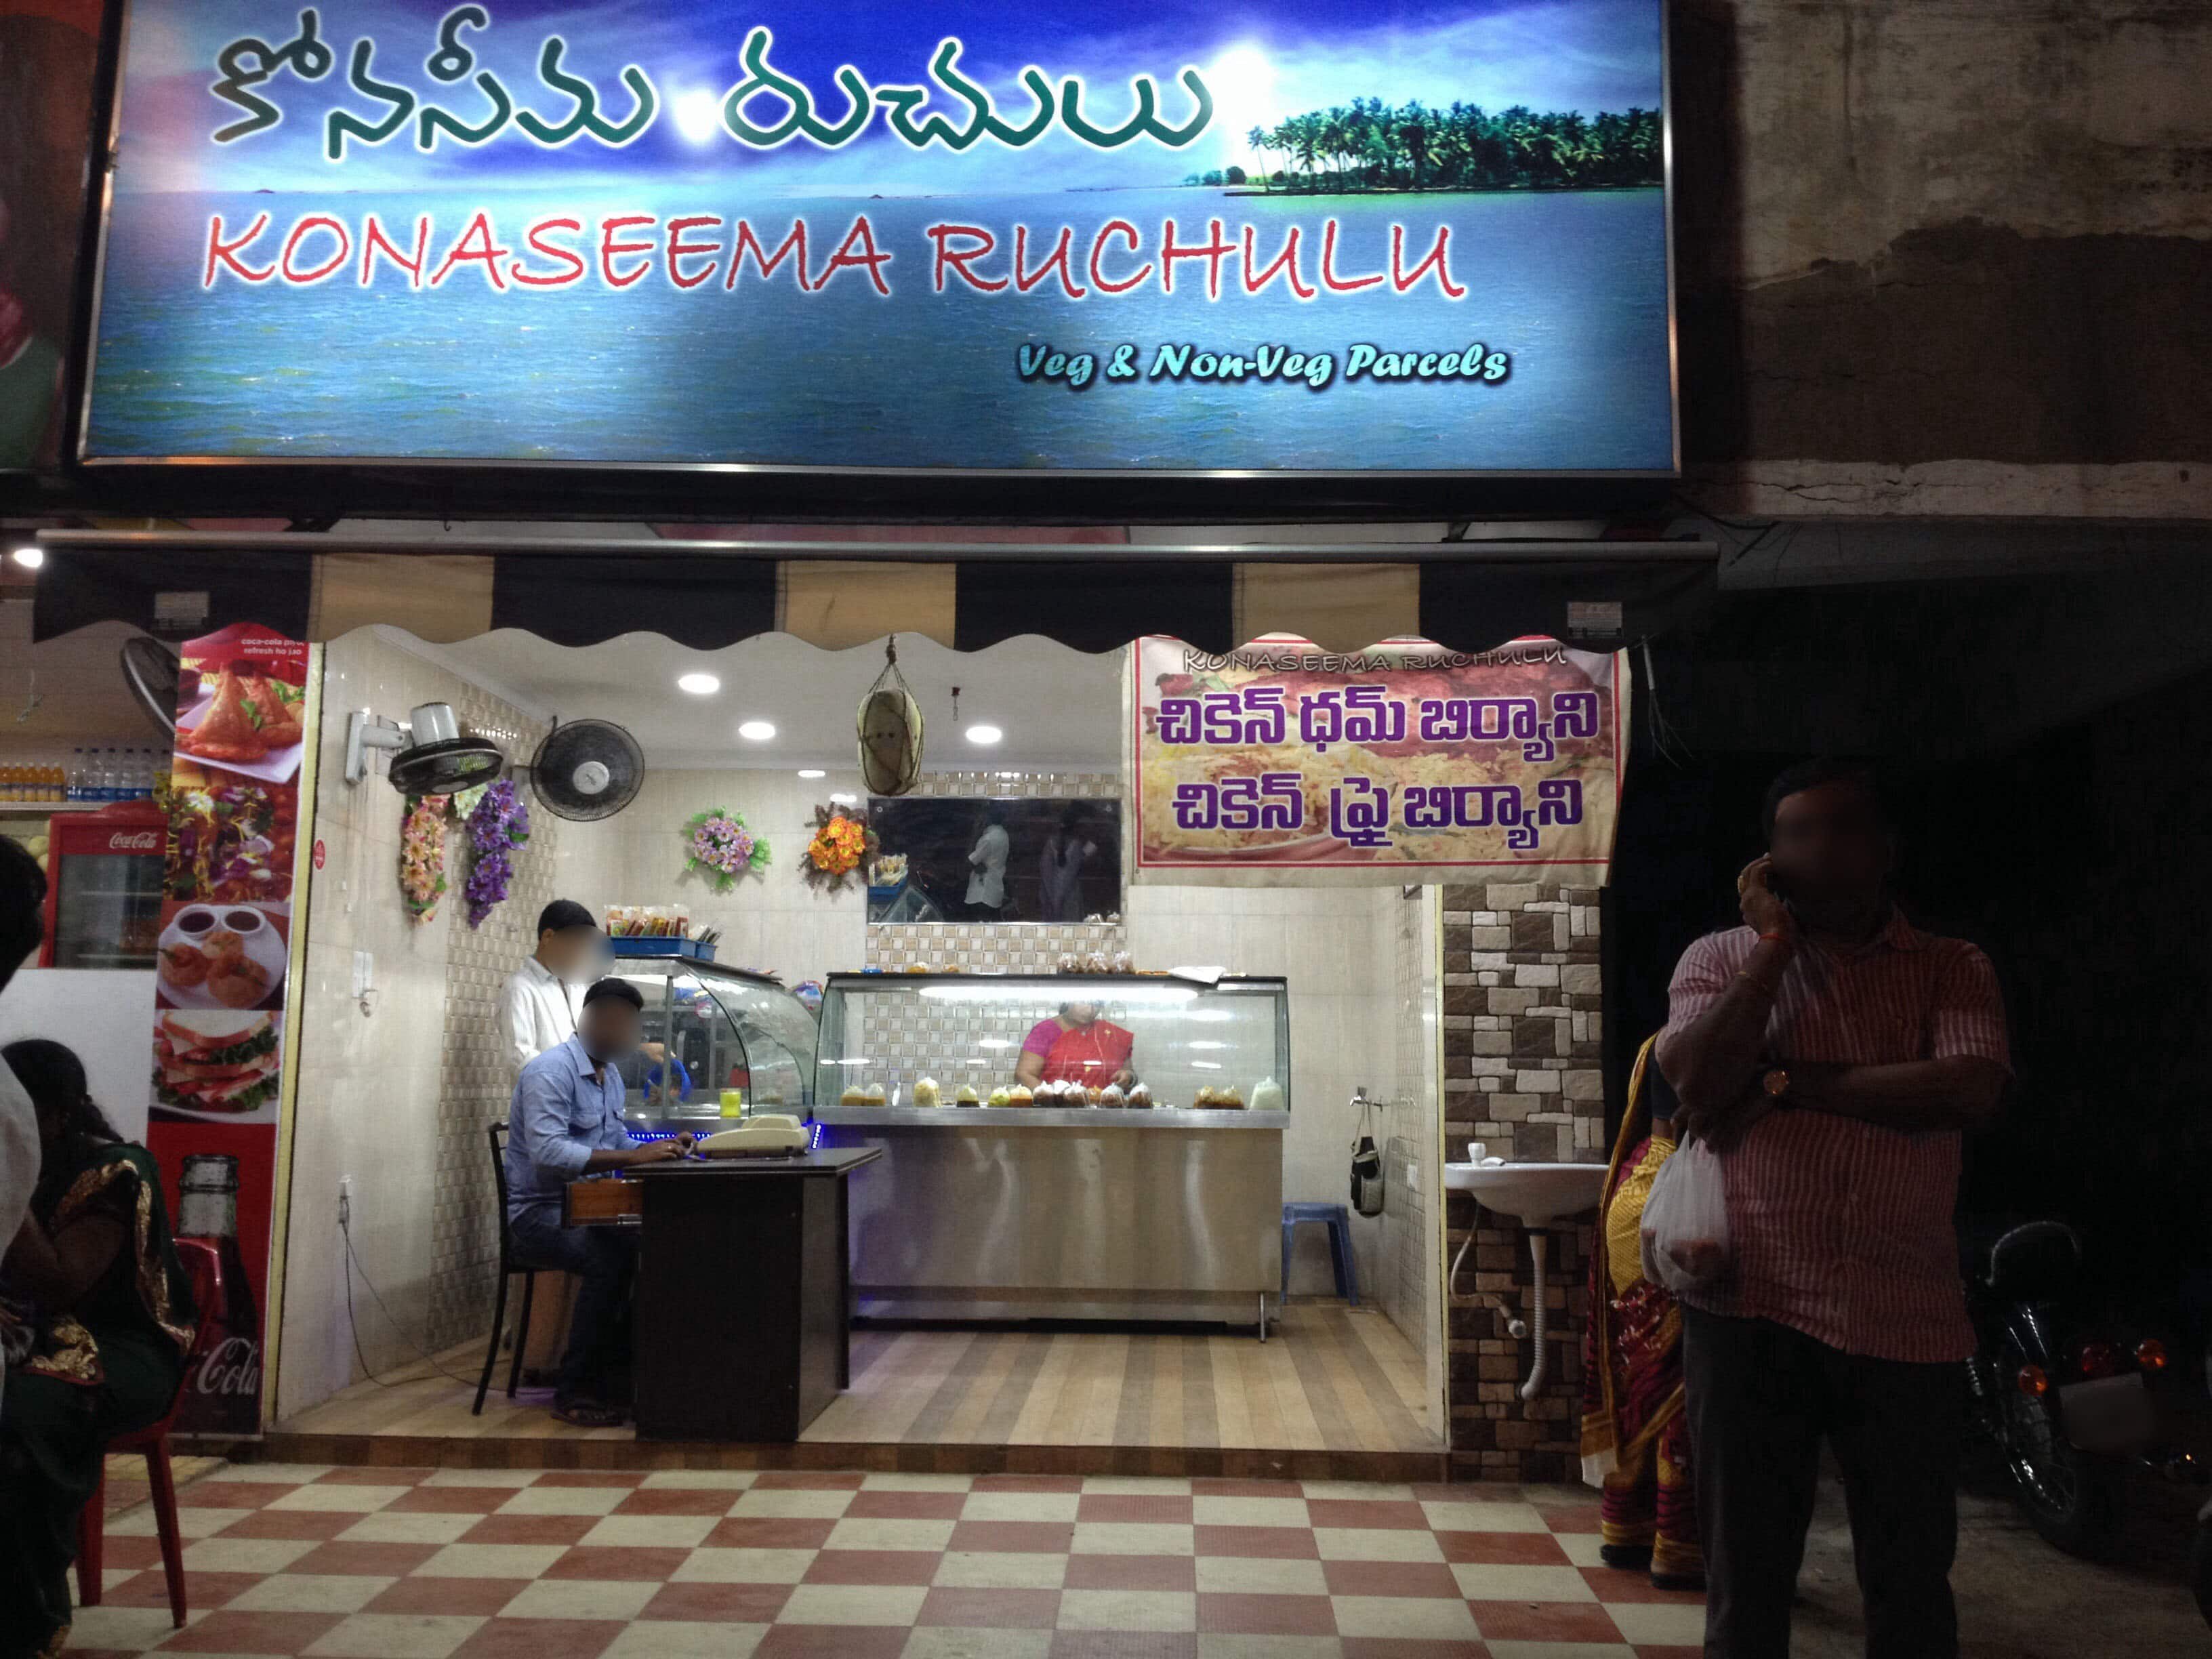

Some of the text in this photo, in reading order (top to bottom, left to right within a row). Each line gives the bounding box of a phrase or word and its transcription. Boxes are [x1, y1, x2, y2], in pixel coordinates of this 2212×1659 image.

[212, 5, 1213, 159] కోనసీమ రుచులు
[205, 213, 1465, 298] KONASEEMA RUCHULU
[1019, 344, 1507, 387] Veg & Non-Veg Parcels
[1183, 647, 1568, 673] KONASEEMA RUCHULU
[1155, 686, 1599, 762] చికెన్ ధమ్ బిర్యాని
[1172, 773, 1303, 830] చికెన్
[1404, 779, 1583, 849] బిర్యాని
